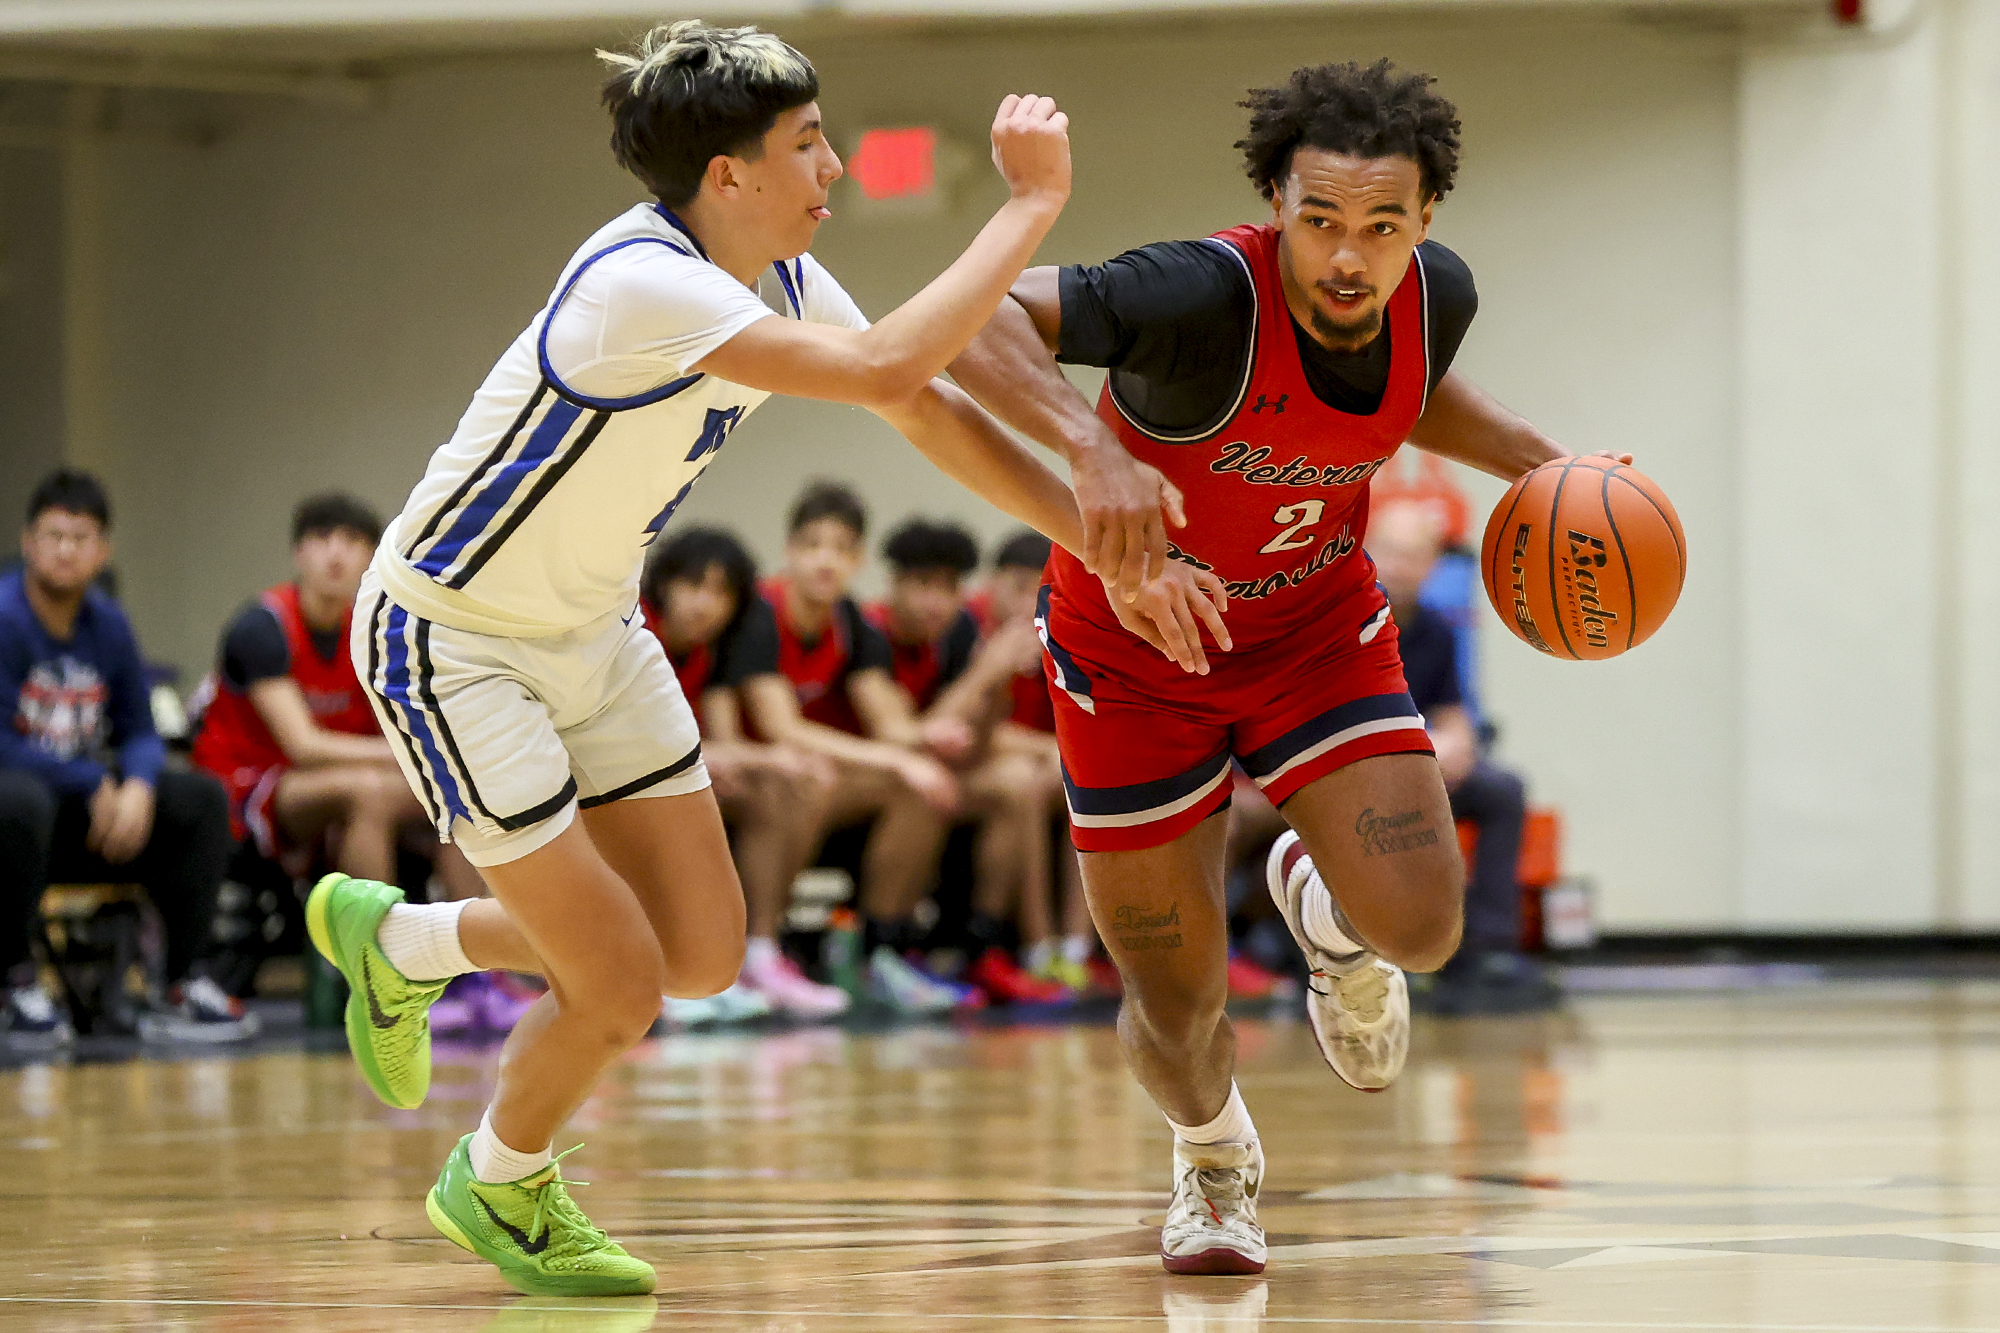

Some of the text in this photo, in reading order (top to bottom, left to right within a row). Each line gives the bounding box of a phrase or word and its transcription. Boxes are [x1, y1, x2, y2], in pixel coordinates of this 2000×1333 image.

[1256, 498, 1327, 555] 2
[1511, 523, 1532, 622] ELITE
[1567, 529, 1617, 648] Baden
